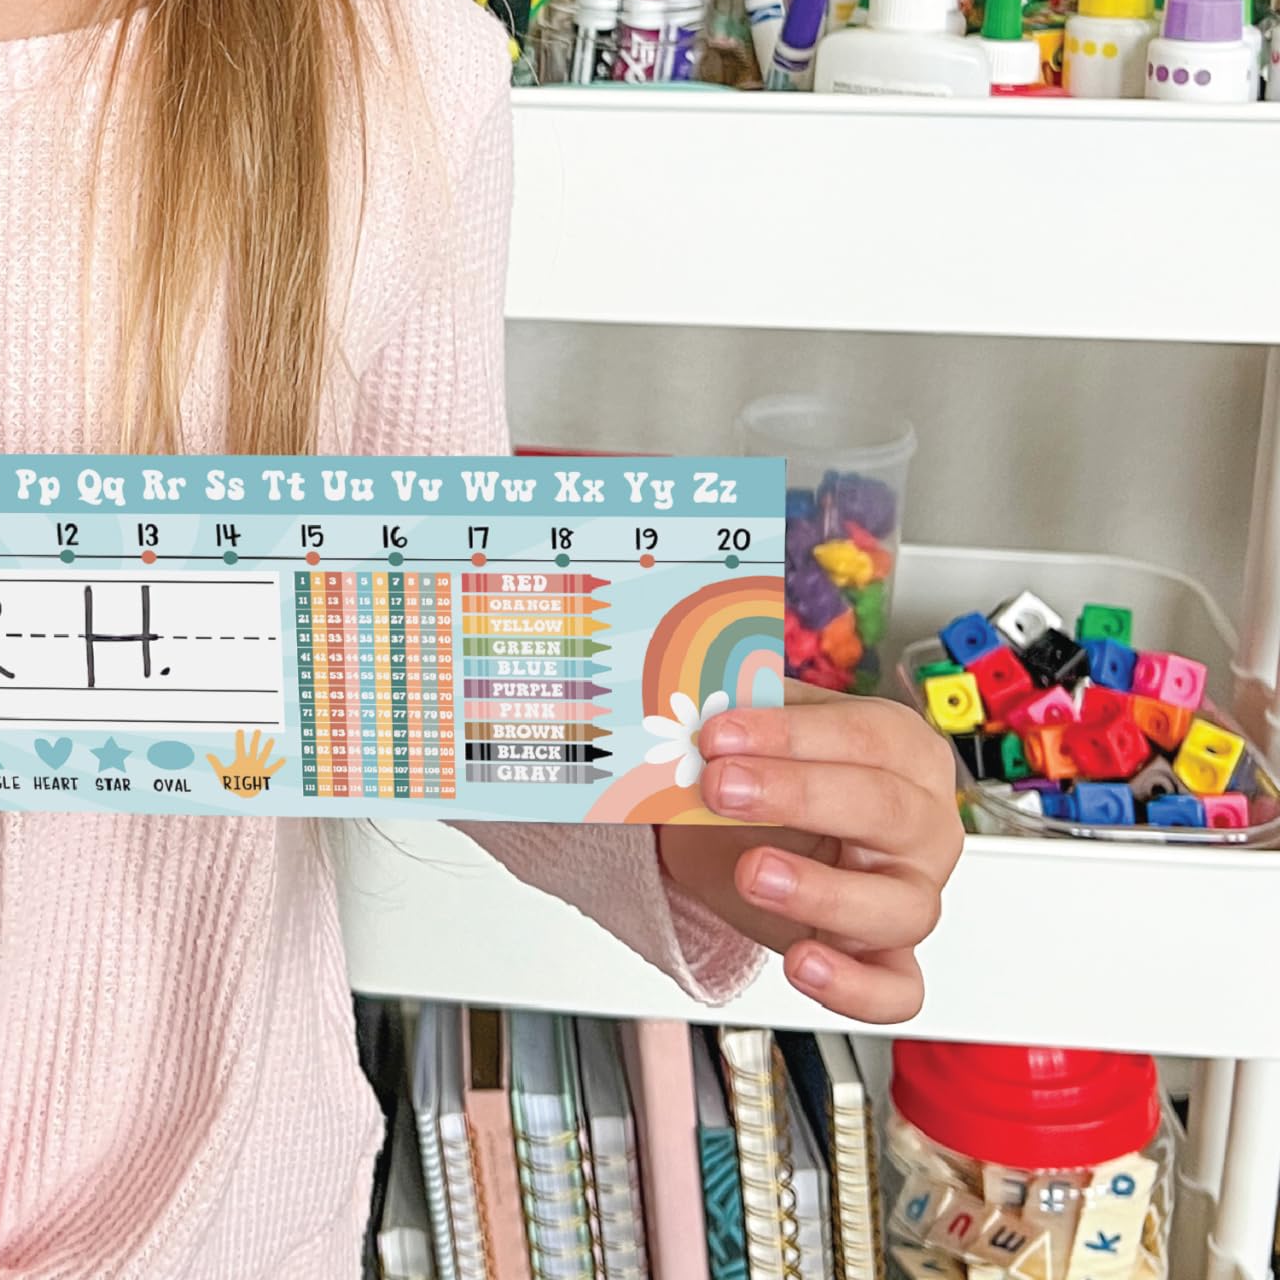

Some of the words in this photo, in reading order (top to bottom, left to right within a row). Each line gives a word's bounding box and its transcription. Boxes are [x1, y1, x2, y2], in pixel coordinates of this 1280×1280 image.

[15, 468, 61, 506] Pp
[77, 468, 126, 507] Qq
[142, 469, 187, 501] Rr
[205, 469, 245, 501] Ss
[261, 470, 305, 501] Tt
[321, 470, 374, 502] Uu
[391, 470, 443, 502] Vv
[460, 471, 537, 503] Ww
[554, 471, 605, 503] Xx
[623, 471, 675, 510] Yy
[693, 471, 737, 504] Zz
[57, 522, 79, 546] 12
[137, 523, 159, 547] 13
[216, 523, 241, 547] 14
[301, 524, 324, 548] 15
[382, 525, 408, 549] 16
[468, 526, 489, 549] 17
[551, 527, 574, 550] 18
[635, 527, 658, 550] 19
[717, 528, 751, 551] 20
[392, 578, 400, 586] 7
[501, 575, 547, 592] RED
[390, 598, 402, 606] 17
[489, 599, 561, 611] ORANGE
[390, 616, 404, 624] 27
[490, 619, 563, 633] YELLOW
[83, 584, 171, 687] H.
[391, 635, 404, 644] 37
[492, 640, 561, 655] GREEN
[392, 654, 405, 663] 47
[497, 660, 557, 676] BLUE
[392, 672, 406, 680] 57
[492, 683, 563, 697] PURPLE
[499, 702, 556, 718] PINK
[493, 724, 565, 739] BROWN
[497, 745, 561, 760] BLACK
[497, 765, 560, 782] GRAY
[34, 777, 79, 790] HEART
[95, 778, 131, 791] STAR
[153, 779, 192, 792] OVAL
[223, 775, 272, 790] RIGHT
